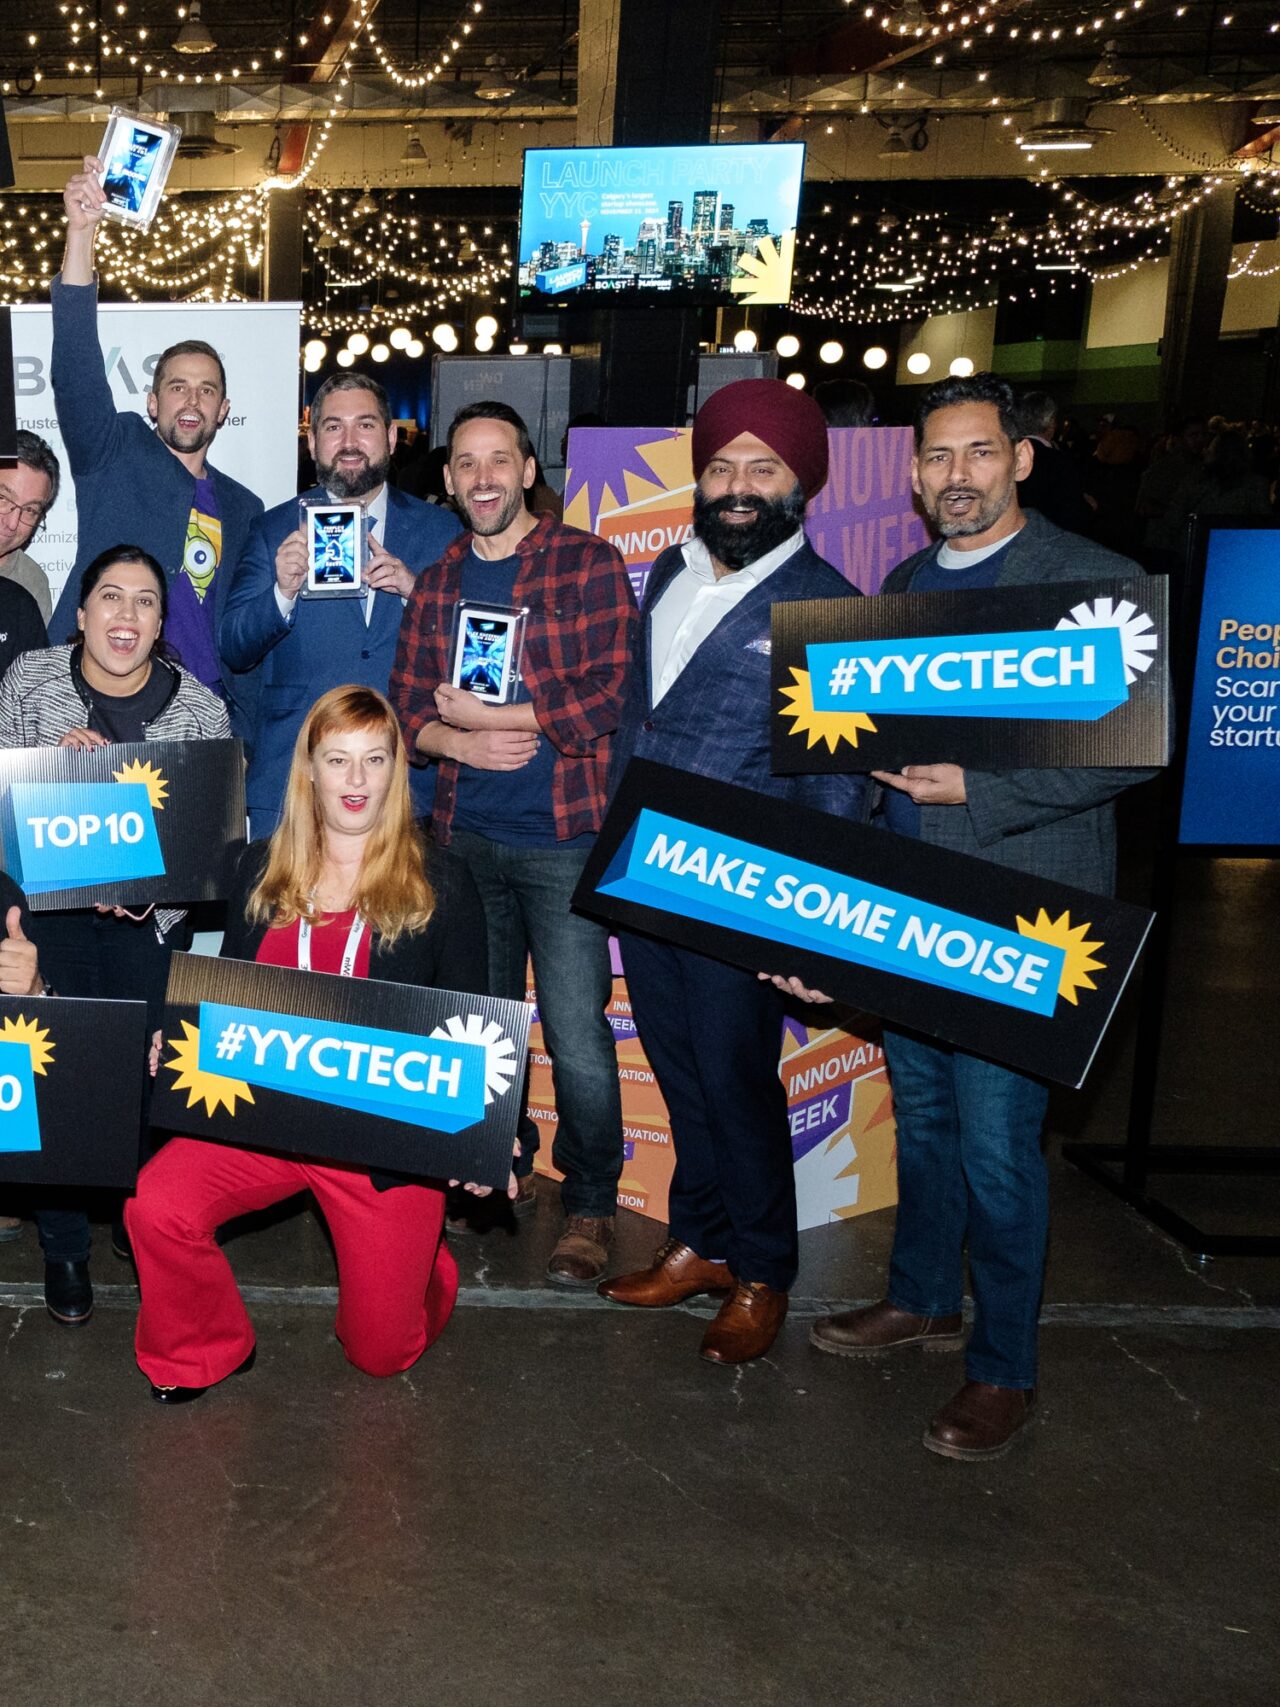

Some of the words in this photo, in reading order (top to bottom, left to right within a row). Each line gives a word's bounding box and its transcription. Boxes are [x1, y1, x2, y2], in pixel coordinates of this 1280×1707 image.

[541, 160, 664, 188] LAUNCH
[672, 156, 770, 185] PARTY
[540, 192, 598, 218] YYC
[828, 645, 1096, 696] #YYCTECH
[1212, 705, 1277, 729] your
[27, 815, 101, 849] TOP
[105, 811, 144, 844] 10
[644, 833, 767, 900] MAKE
[765, 874, 896, 943] SOME
[897, 915, 1050, 996] NOISE
[216, 1021, 462, 1098] #YYCTECH
[787, 1095, 839, 1137] EEK
